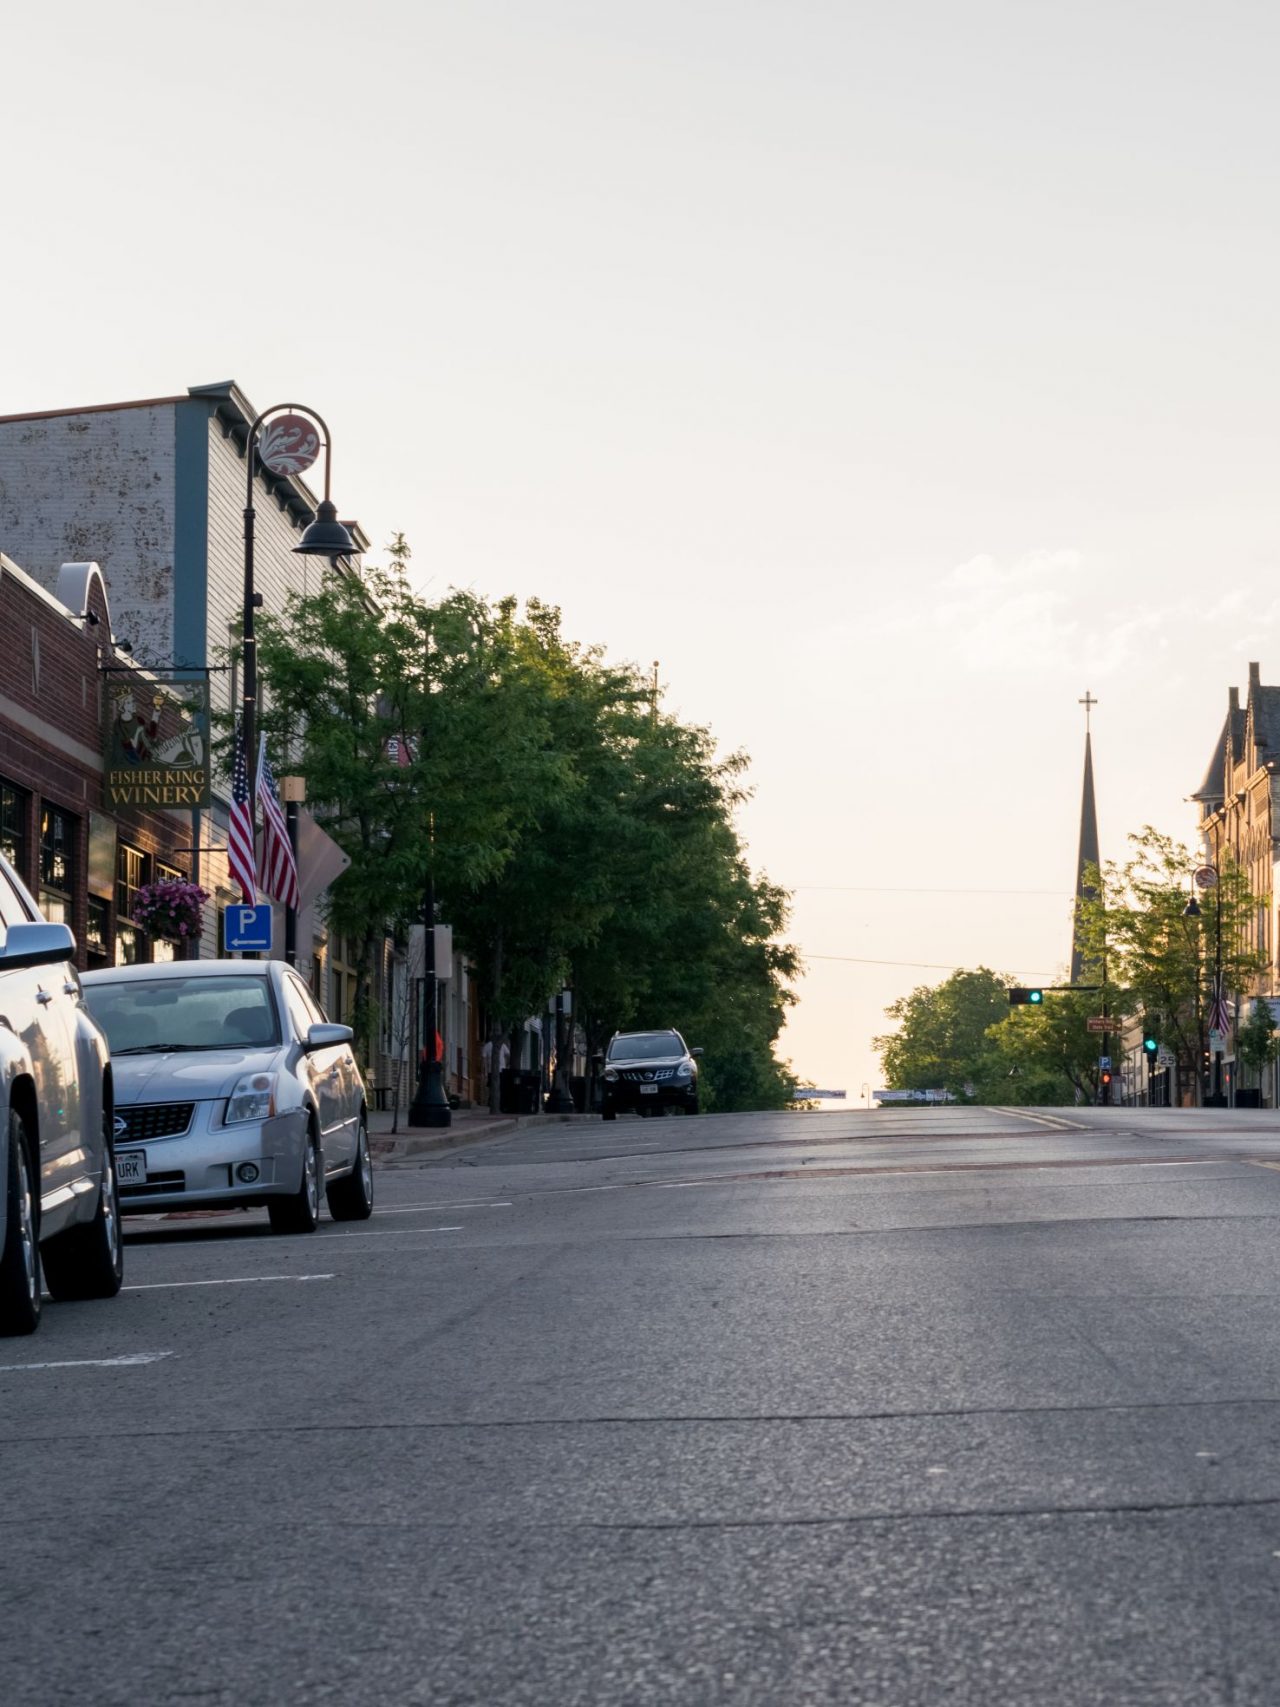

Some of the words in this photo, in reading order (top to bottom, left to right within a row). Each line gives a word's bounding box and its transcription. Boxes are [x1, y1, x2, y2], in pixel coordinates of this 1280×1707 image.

[110, 770, 162, 785] FISHER
[165, 770, 205, 785] KING
[110, 786, 205, 804] WINERY
[240, 909, 257, 934] P
[1160, 1055, 1175, 1065] 25
